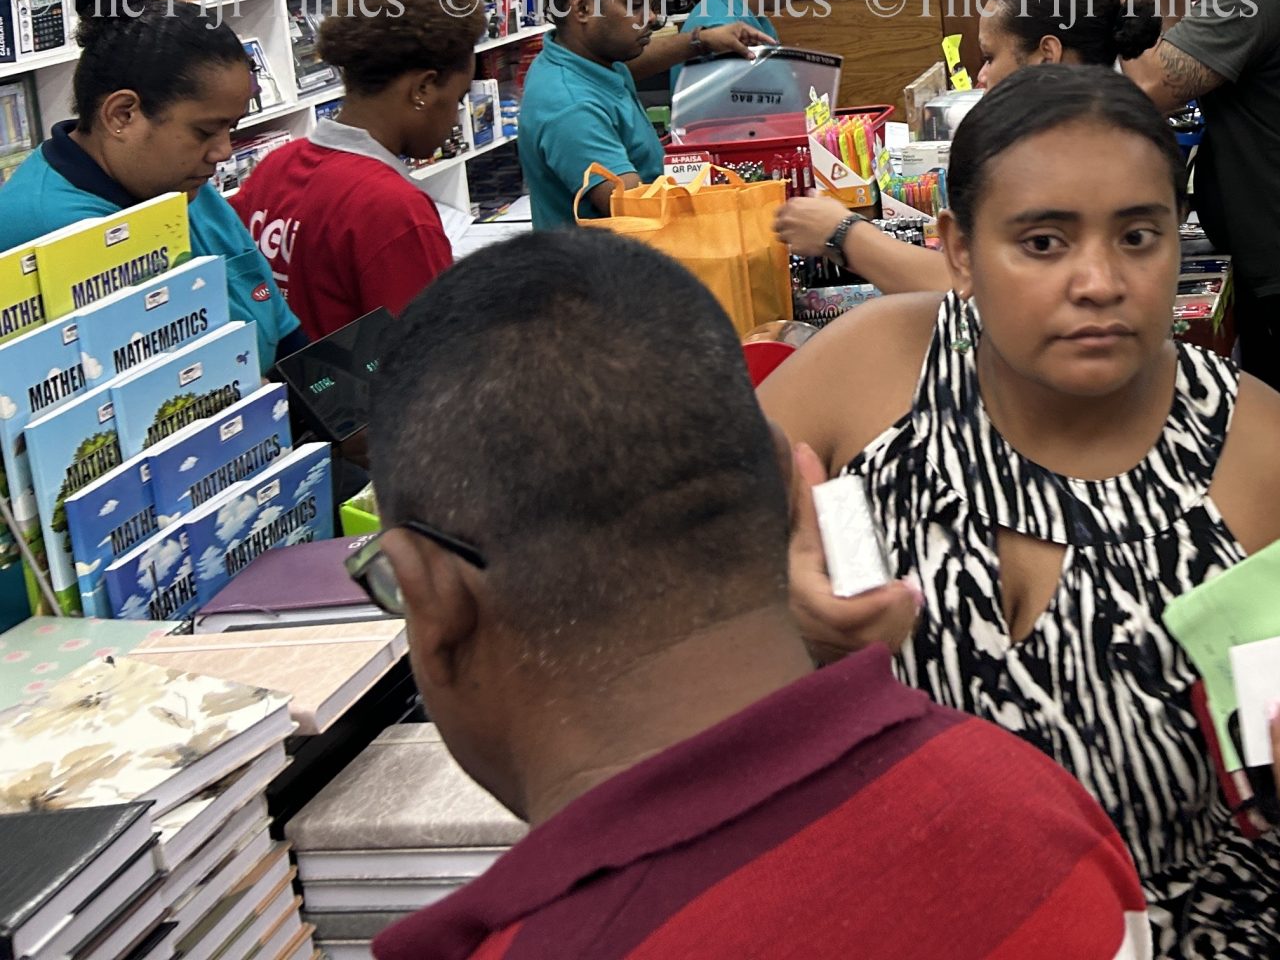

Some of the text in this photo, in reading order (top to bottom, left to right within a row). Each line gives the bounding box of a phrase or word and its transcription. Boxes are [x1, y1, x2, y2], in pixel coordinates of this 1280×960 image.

[731, 93, 782, 104] FILE BAG
[672, 155, 702, 164] M-PAISA
[672, 164, 702, 174] QR PAY
[72, 246, 168, 310] MATHEMATICS
[113, 308, 208, 374] MATHEMATICS
[145, 380, 242, 448] MATHEMATICS
[310, 377, 335, 394] TOTAL
[189, 434, 281, 508] MATHEMATICS
[225, 496, 317, 576] MATHEMATICS
